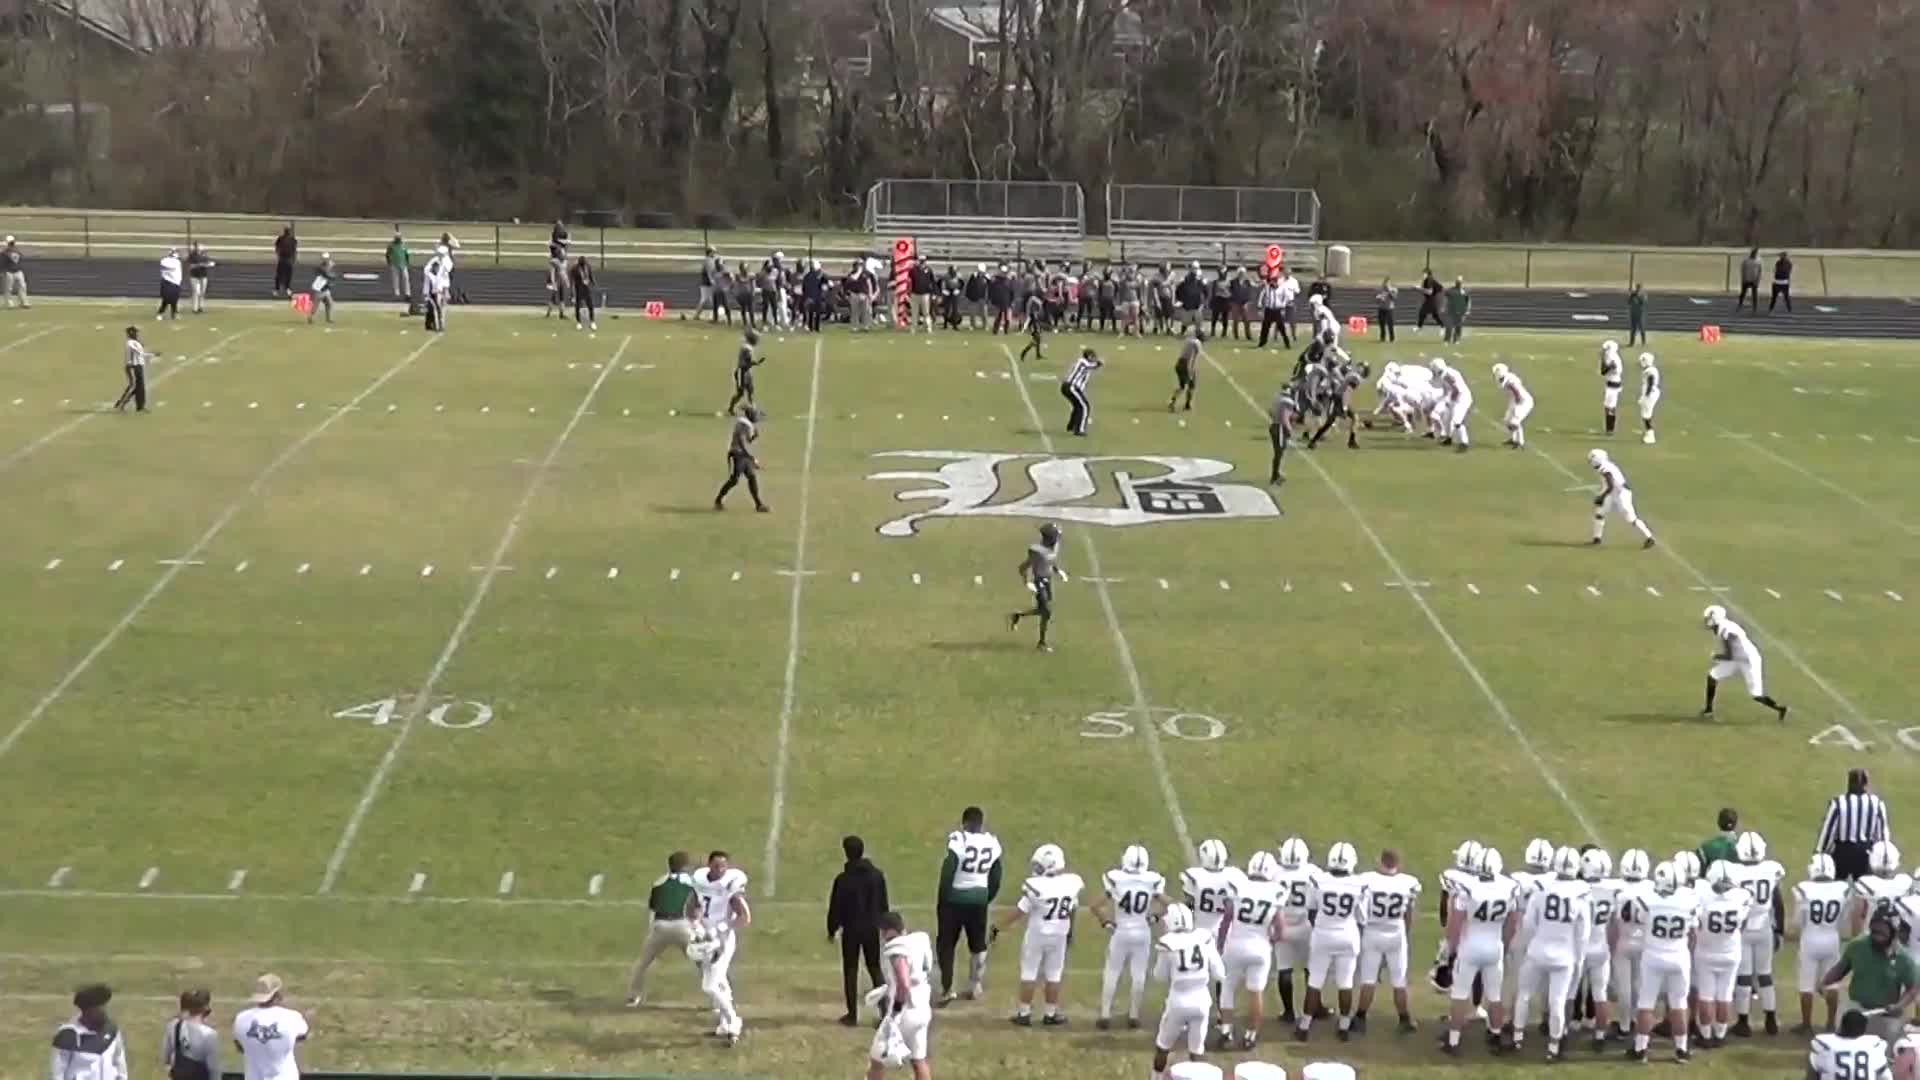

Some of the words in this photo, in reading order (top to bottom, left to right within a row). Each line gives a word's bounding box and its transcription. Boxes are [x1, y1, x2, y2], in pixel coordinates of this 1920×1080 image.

[332, 698, 492, 729] 40
[1079, 712, 1226, 741] 50
[962, 847, 992, 875] 22
[1043, 896, 1072, 921] 78
[1119, 891, 1149, 914] 40
[1238, 897, 1272, 924] 27
[1322, 892, 1354, 917] 59
[1372, 892, 1403, 918] 52
[1474, 900, 1506, 922] 42
[1544, 894, 1571, 923] 81
[1810, 899, 1840, 925] 80
[1652, 915, 1685, 939] 62
[1707, 910, 1737, 933] 65
[1177, 944, 1204, 972] 14
[1835, 1051, 1868, 1080] 58
